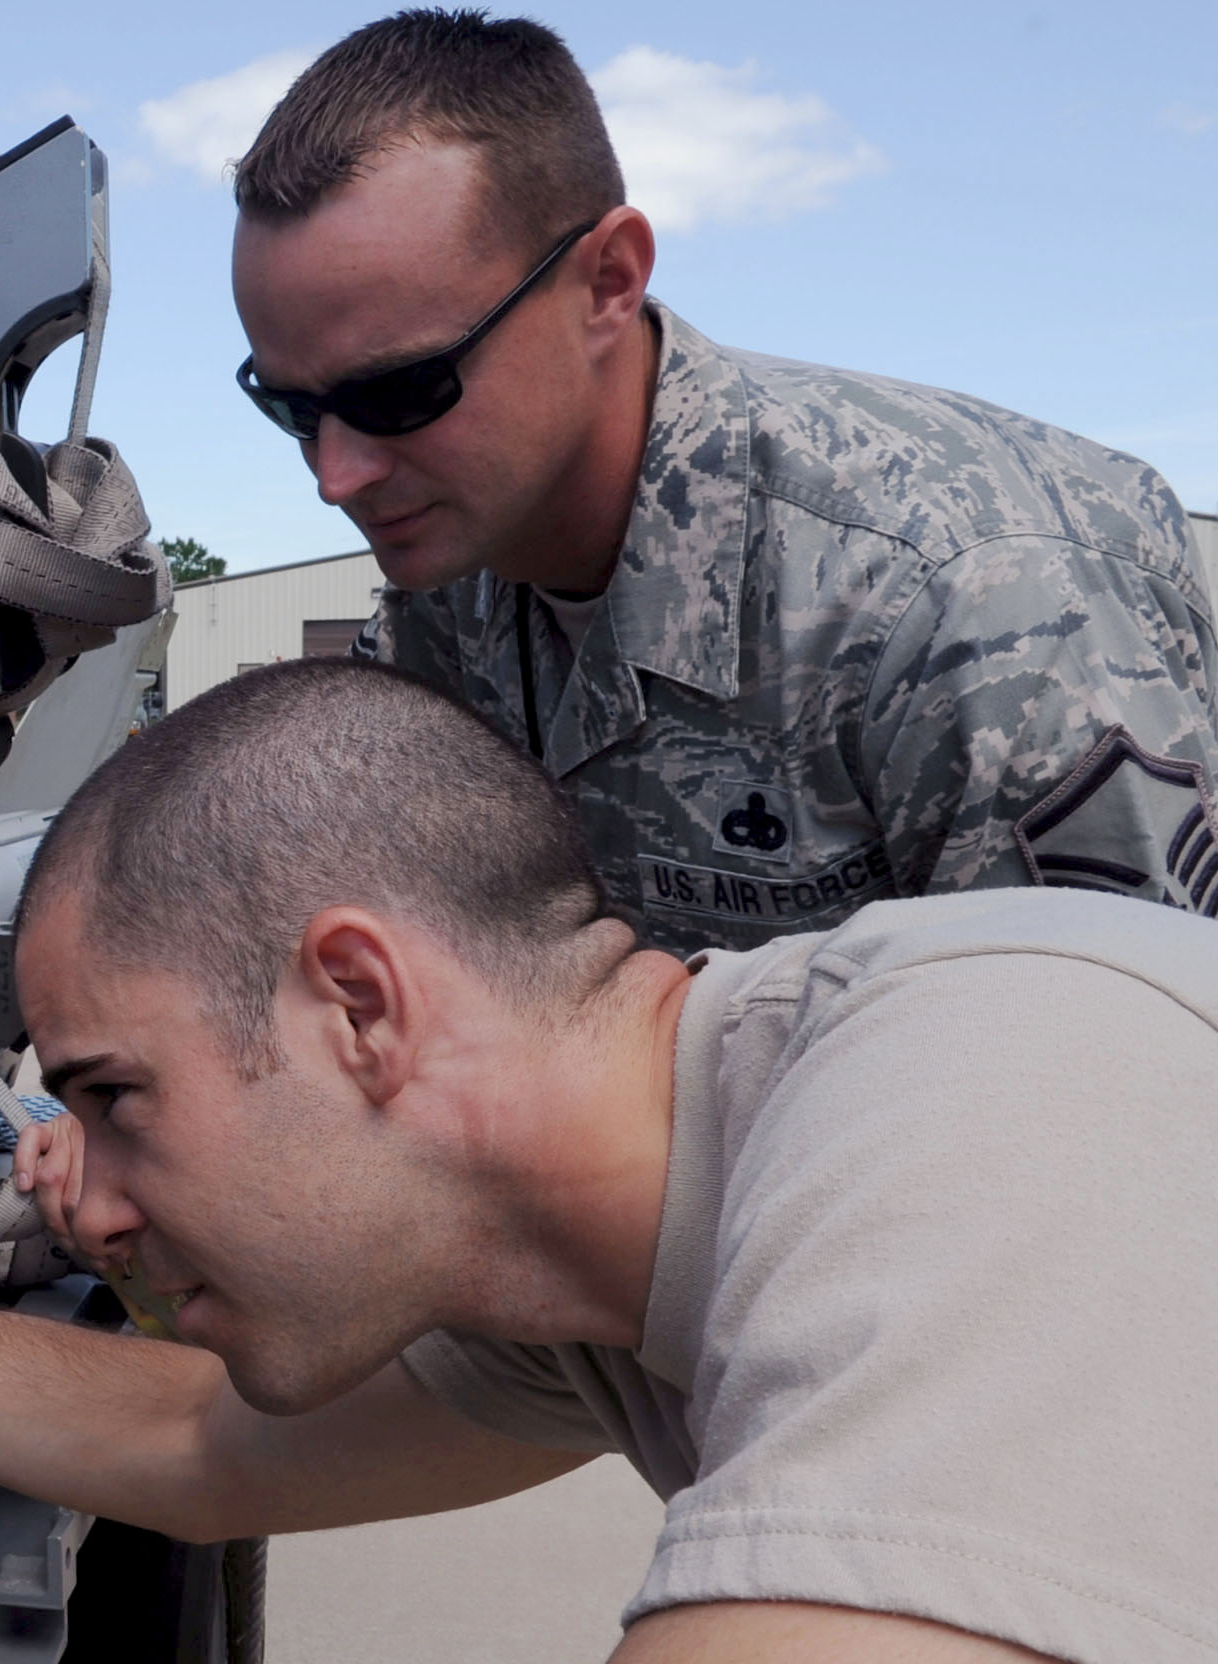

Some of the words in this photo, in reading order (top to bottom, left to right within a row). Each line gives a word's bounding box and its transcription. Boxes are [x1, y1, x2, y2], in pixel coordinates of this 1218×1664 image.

[653, 864, 702, 905] U.S.
[713, 872, 762, 914] AIR
[768, 848, 893, 916] FORCE
